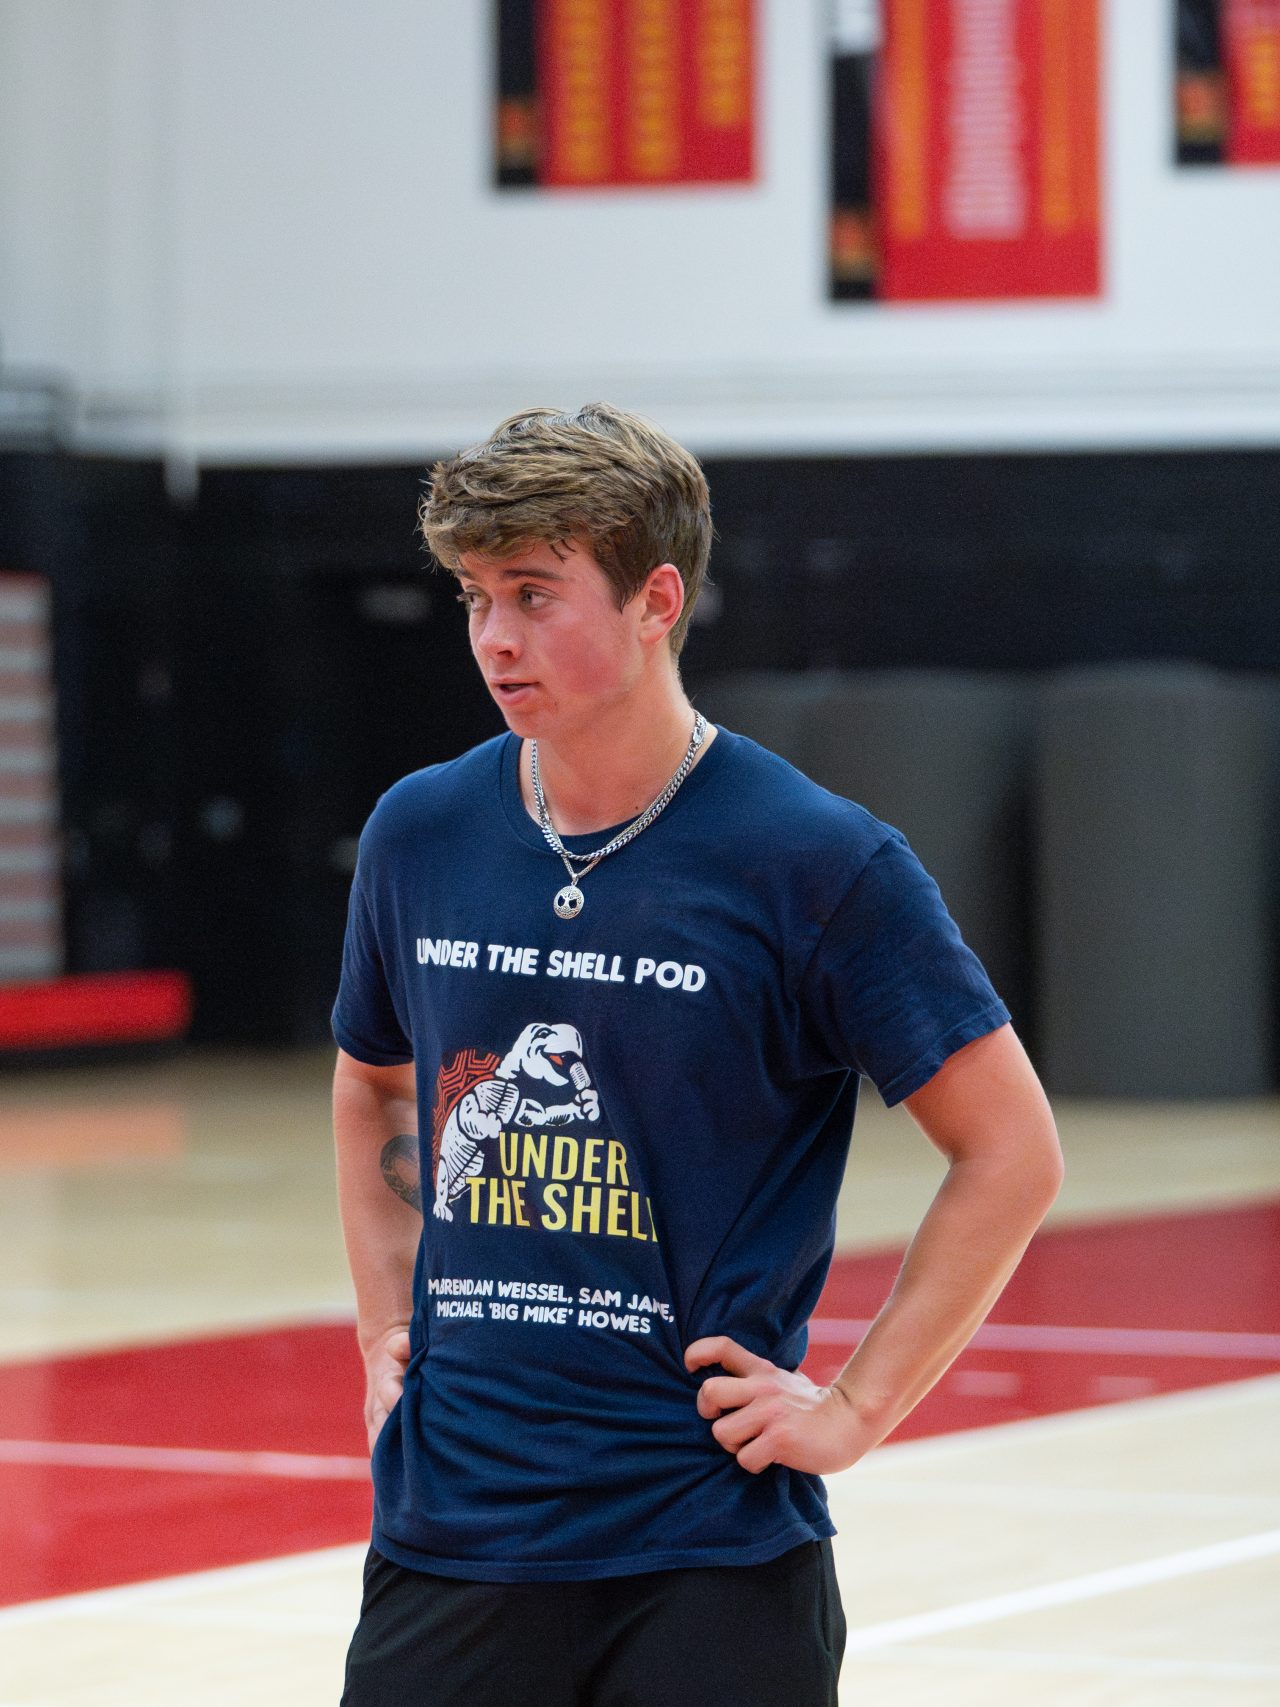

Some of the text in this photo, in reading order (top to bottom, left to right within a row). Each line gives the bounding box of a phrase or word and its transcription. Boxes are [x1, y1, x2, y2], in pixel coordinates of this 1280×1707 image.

[416, 938, 707, 992] UNDER THE SHELL POD
[499, 1131, 630, 1186] UNDER
[466, 1177, 531, 1228] THE
[436, 1300, 485, 1319] MICHAEL
[578, 1310, 651, 1334] HOWES
[497, 1280, 574, 1305] WEISSEL,
[578, 1287, 622, 1308] SAM
